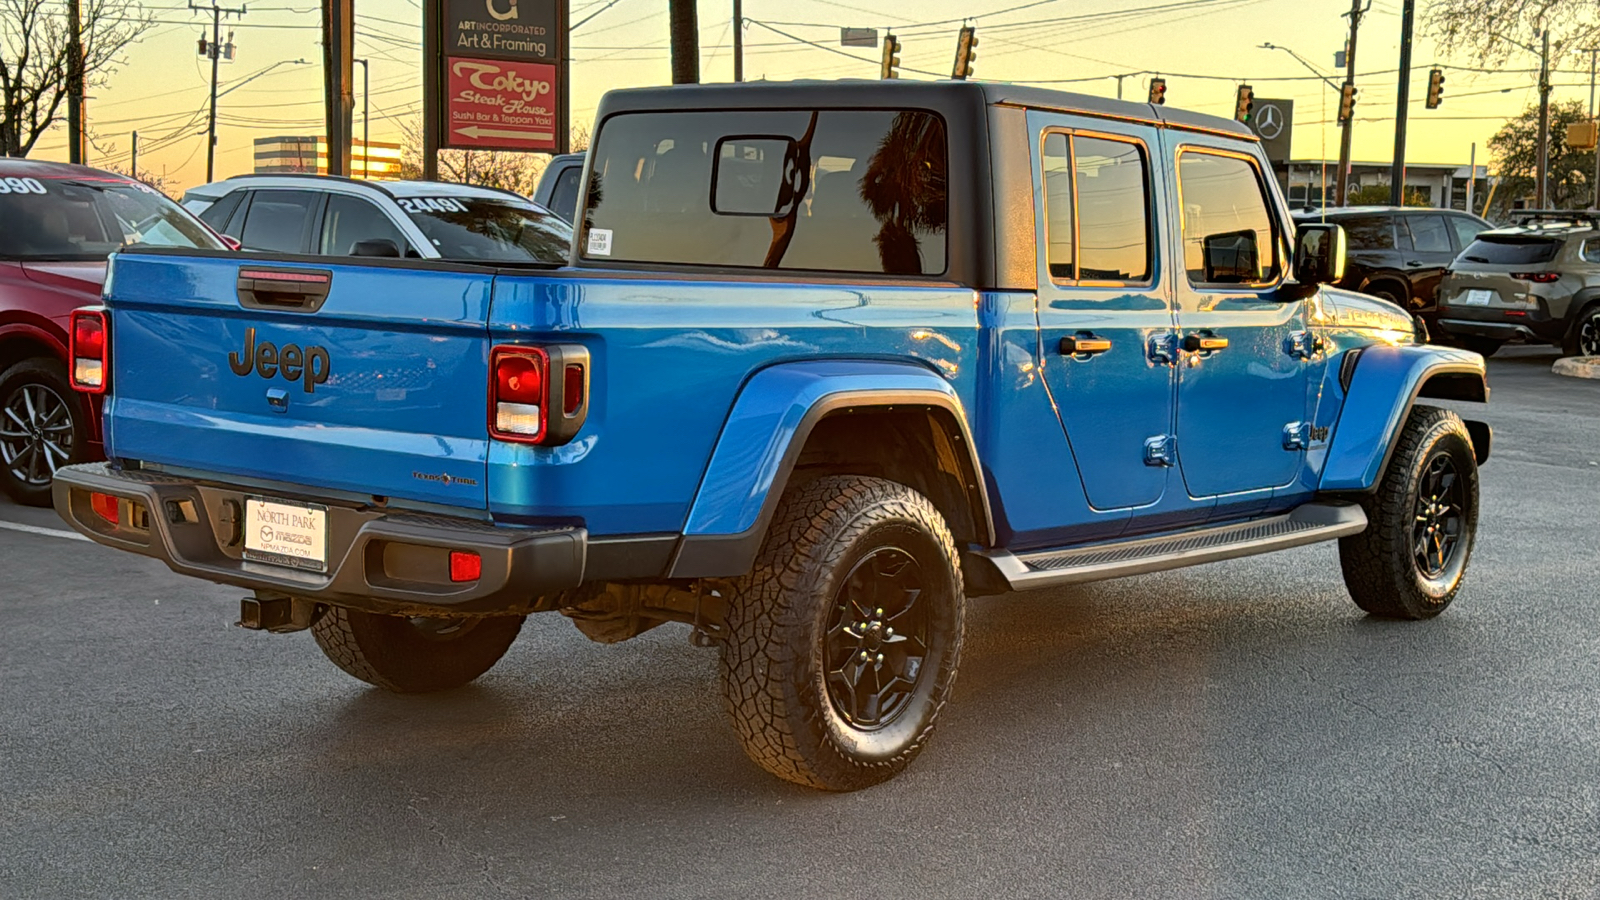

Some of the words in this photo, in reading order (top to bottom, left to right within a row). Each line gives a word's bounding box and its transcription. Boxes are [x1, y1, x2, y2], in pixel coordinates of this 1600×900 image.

[457, 32, 479, 48] Art
[480, 33, 492, 49] &
[493, 34, 547, 57] Framing
[452, 61, 550, 101] Tokyo
[452, 90, 506, 106] Steak
[502, 100, 554, 116] House
[452, 111, 475, 121] Sushi
[476, 112, 491, 121] Bar
[492, 113, 500, 122] &
[501, 114, 534, 125] Teppan
[534, 117, 552, 126] Yaki
[397, 198, 469, 213] 24491
[228, 327, 330, 393] Jeep
[1310, 423, 1329, 443] Jeep
[257, 509, 289, 526] NORTH
[292, 514, 316, 530] PARK
